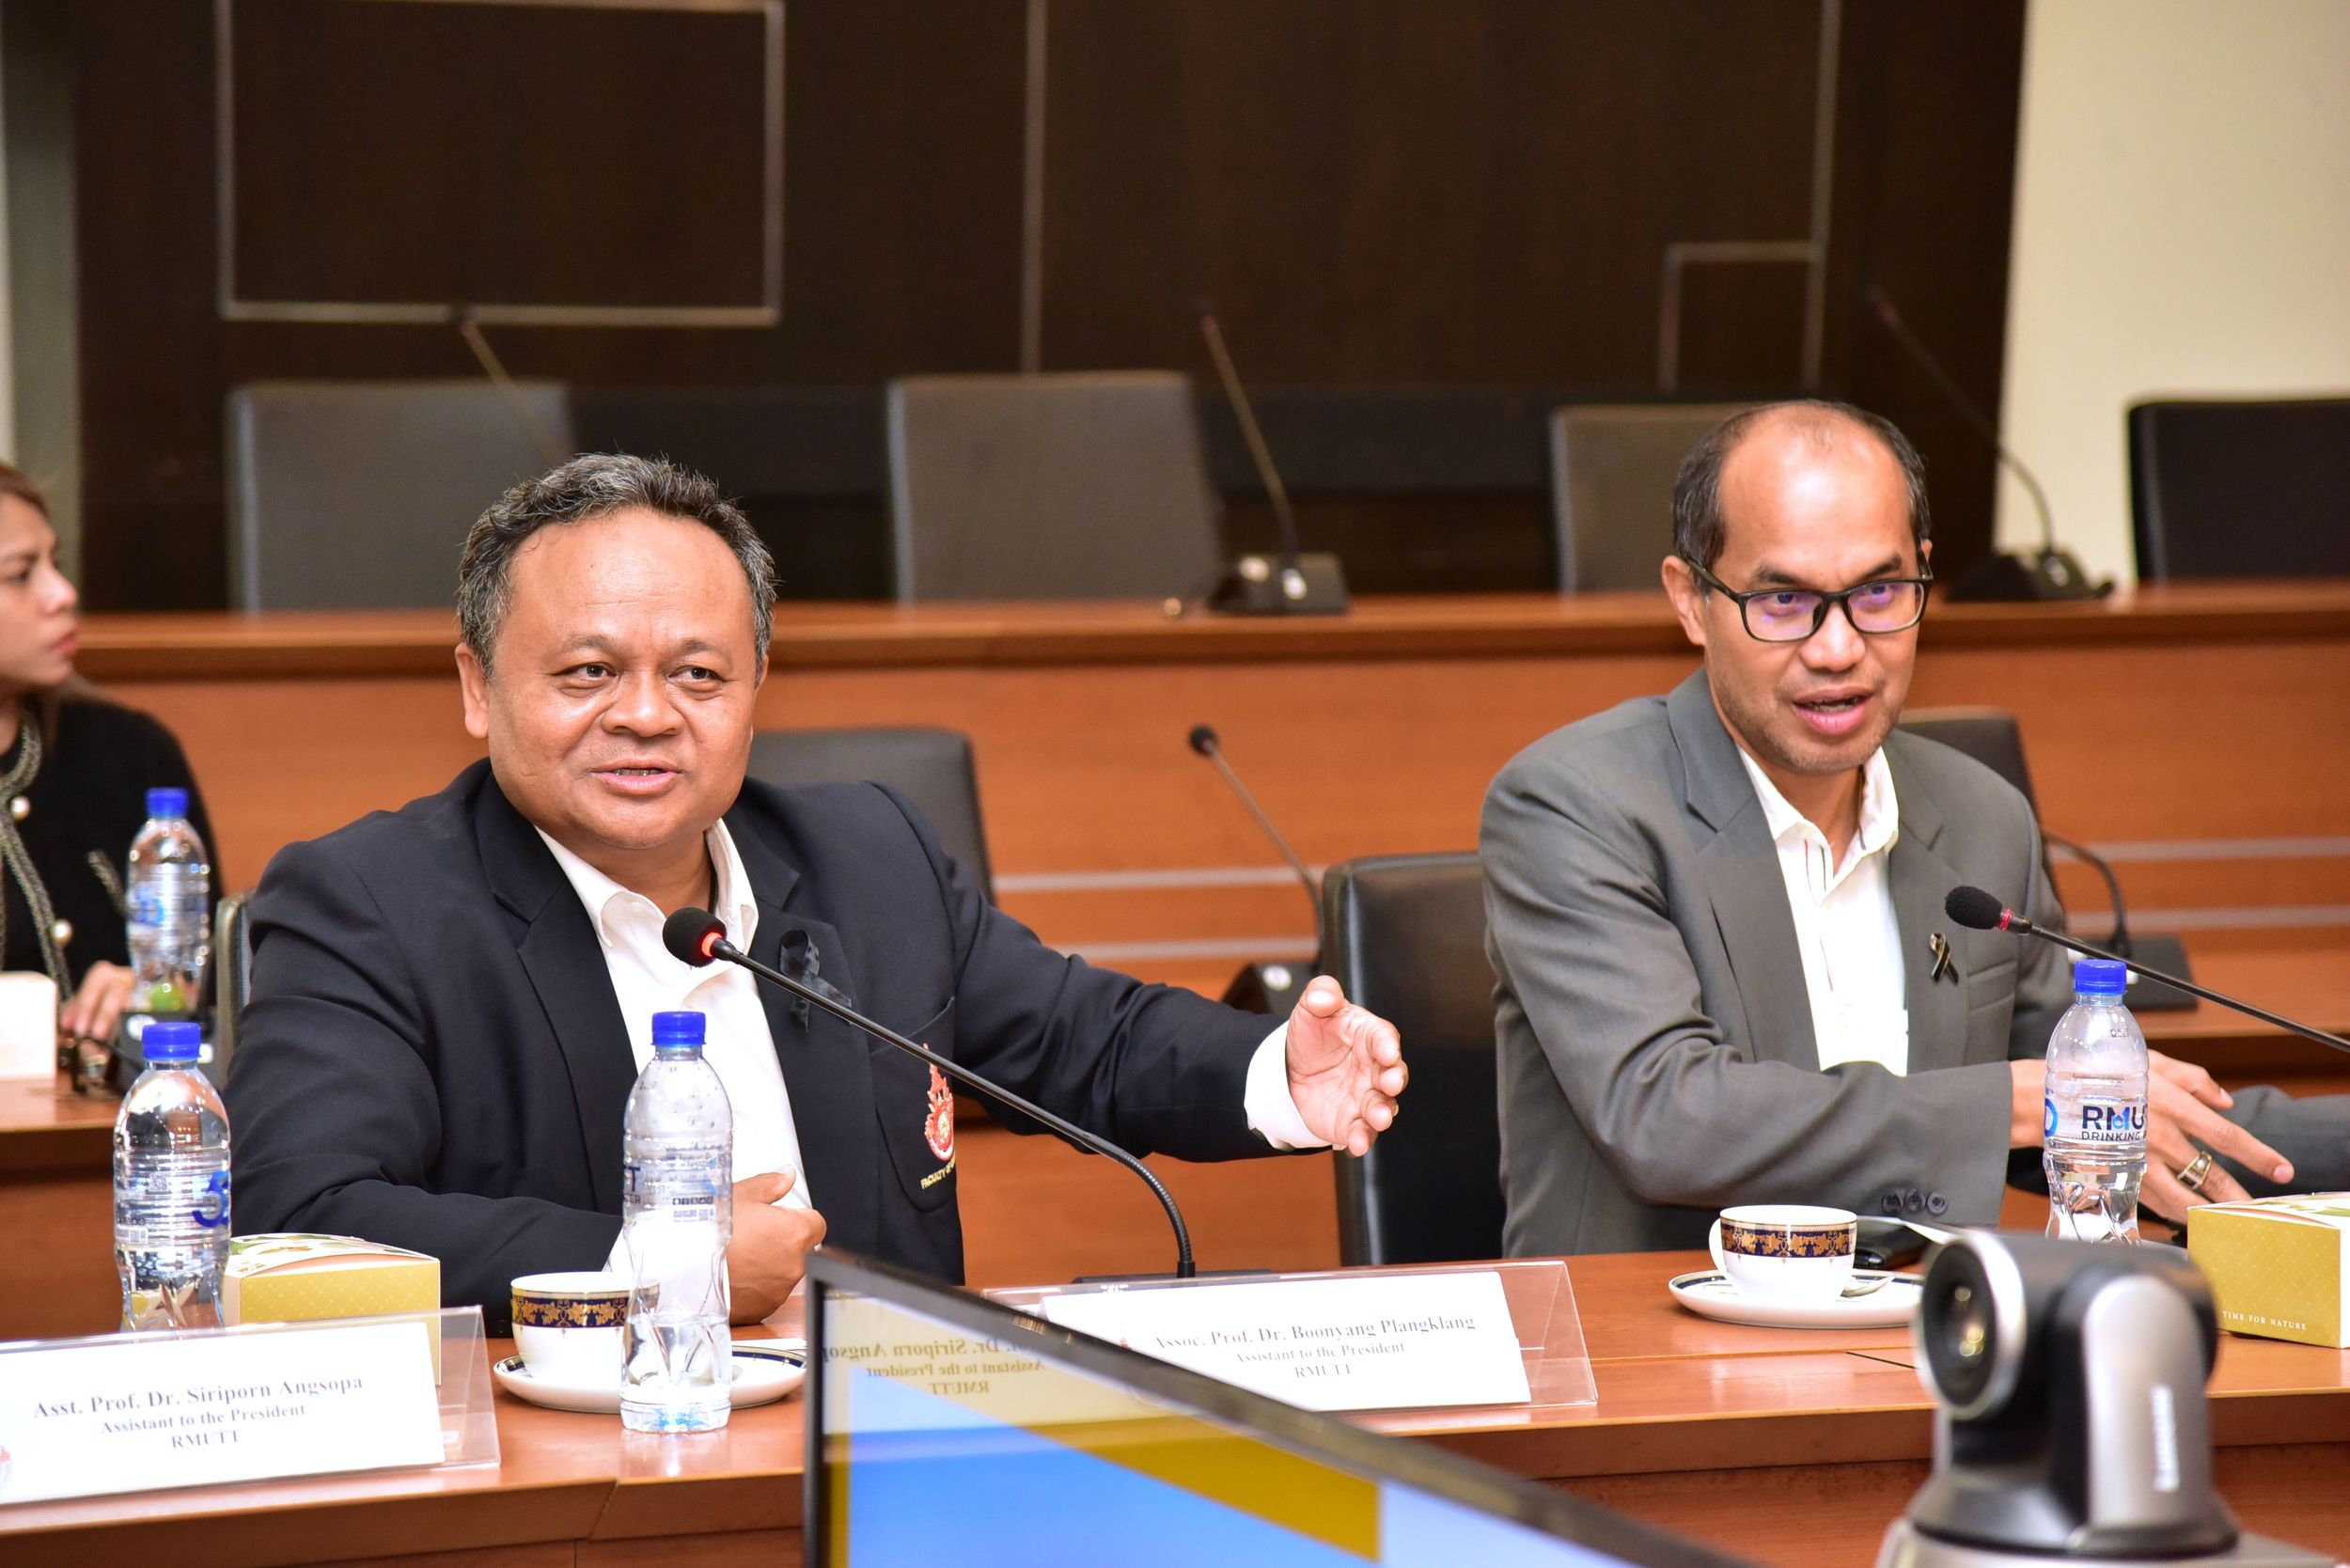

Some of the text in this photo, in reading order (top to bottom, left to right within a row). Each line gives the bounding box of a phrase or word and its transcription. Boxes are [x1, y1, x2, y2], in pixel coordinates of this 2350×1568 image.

[2082, 1104, 2148, 1130] RMU
[2081, 1131, 2140, 1141] DRINKING
[2222, 1309, 2307, 1330] TIME FOR NATURE
[1211, 1329, 1253, 1345] Prof.
[1259, 1327, 1287, 1341] Dr.
[1291, 1325, 1376, 1341] Boonyang
[1380, 1316, 1476, 1334] Plangklang
[1236, 1342, 1405, 1363] Assistant to the President
[1294, 1364, 1351, 1378] RMUTT
[34, 1378, 363, 1418] Asst. Prof. Dr. Siriporn Angsopa
[102, 1404, 306, 1434] Assistant to the President
[171, 1430, 241, 1448] RMUTT
